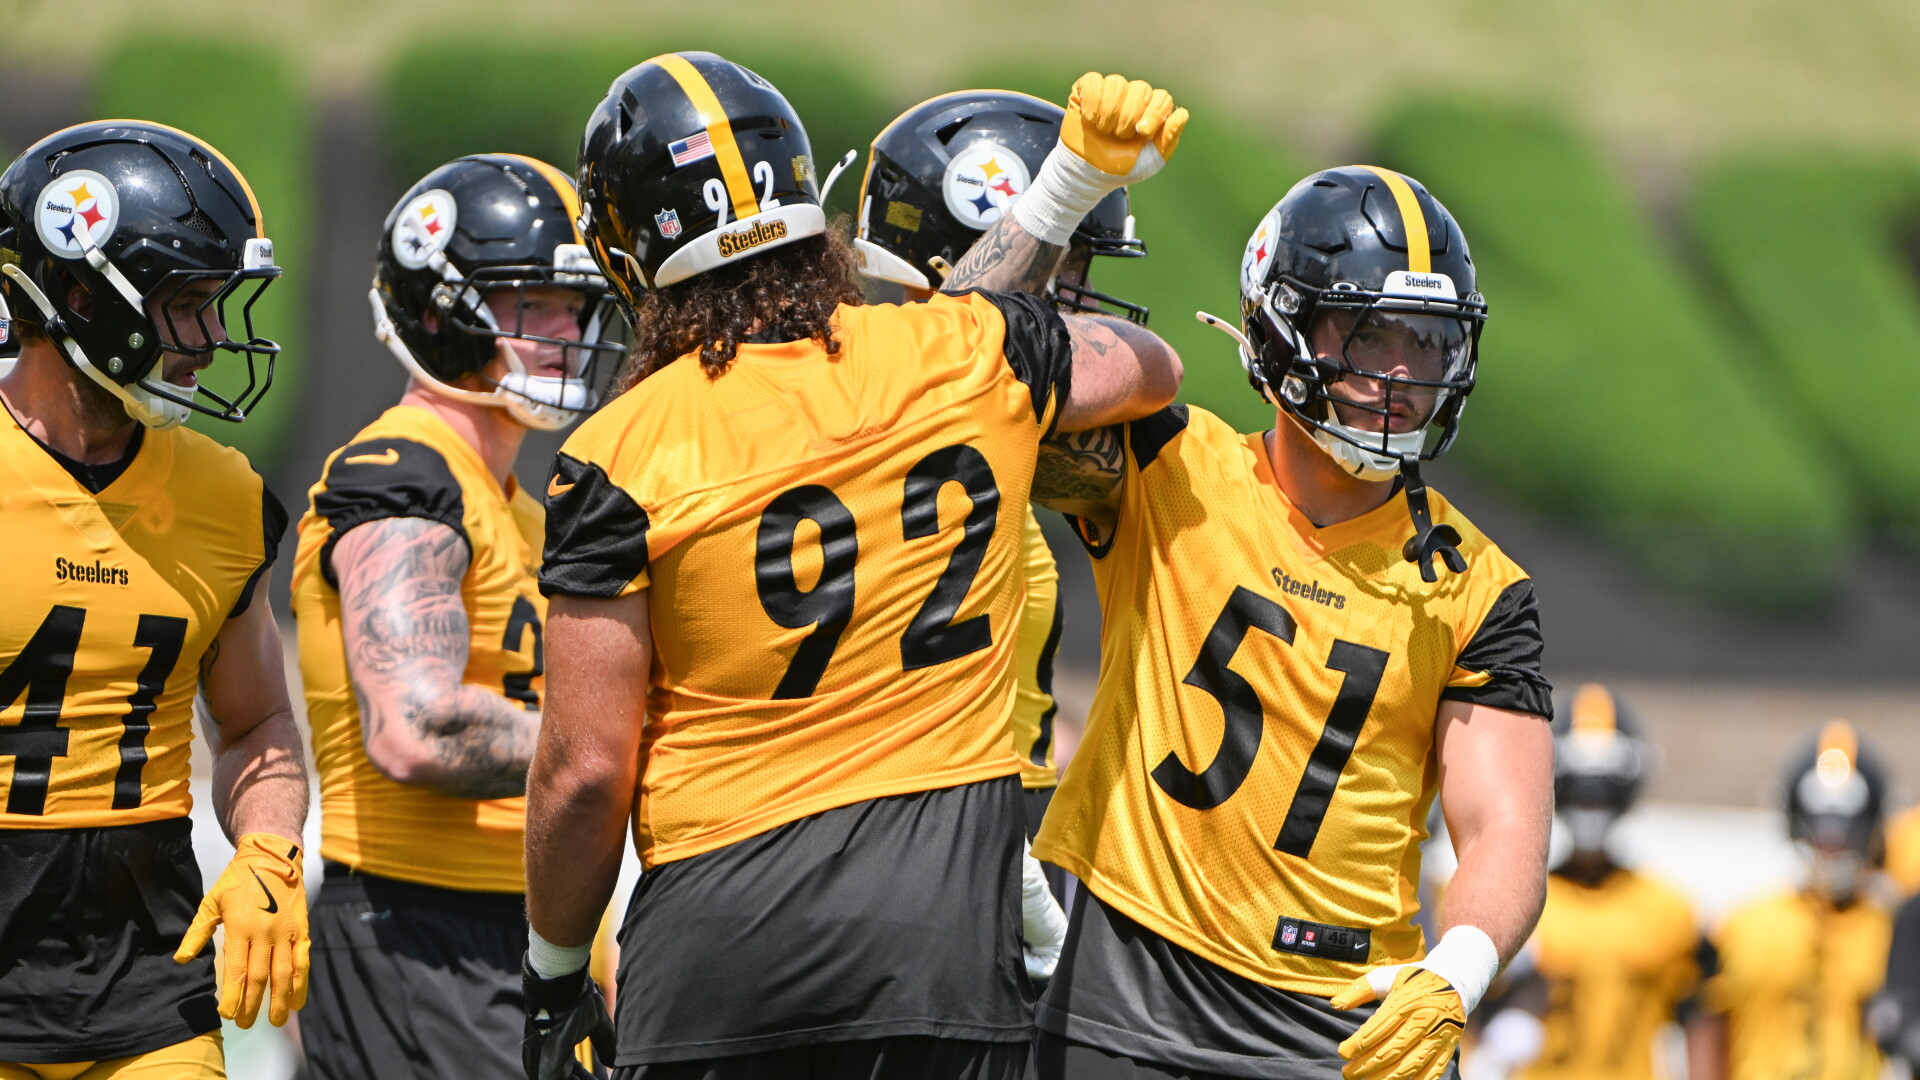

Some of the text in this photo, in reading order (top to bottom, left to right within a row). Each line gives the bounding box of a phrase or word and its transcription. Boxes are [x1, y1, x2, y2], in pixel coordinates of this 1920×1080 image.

[955, 173, 984, 188] Steelers
[46, 200, 73, 215] Steelers
[660, 221, 679, 236] NFL
[717, 218, 788, 258] Steelers
[1404, 274, 1442, 290] Steelers
[55, 556, 129, 586] Steelers
[755, 443, 1001, 701] 92
[1270, 566, 1347, 610] Steelers
[0, 605, 189, 816] 41
[1151, 585, 1391, 859] 51
